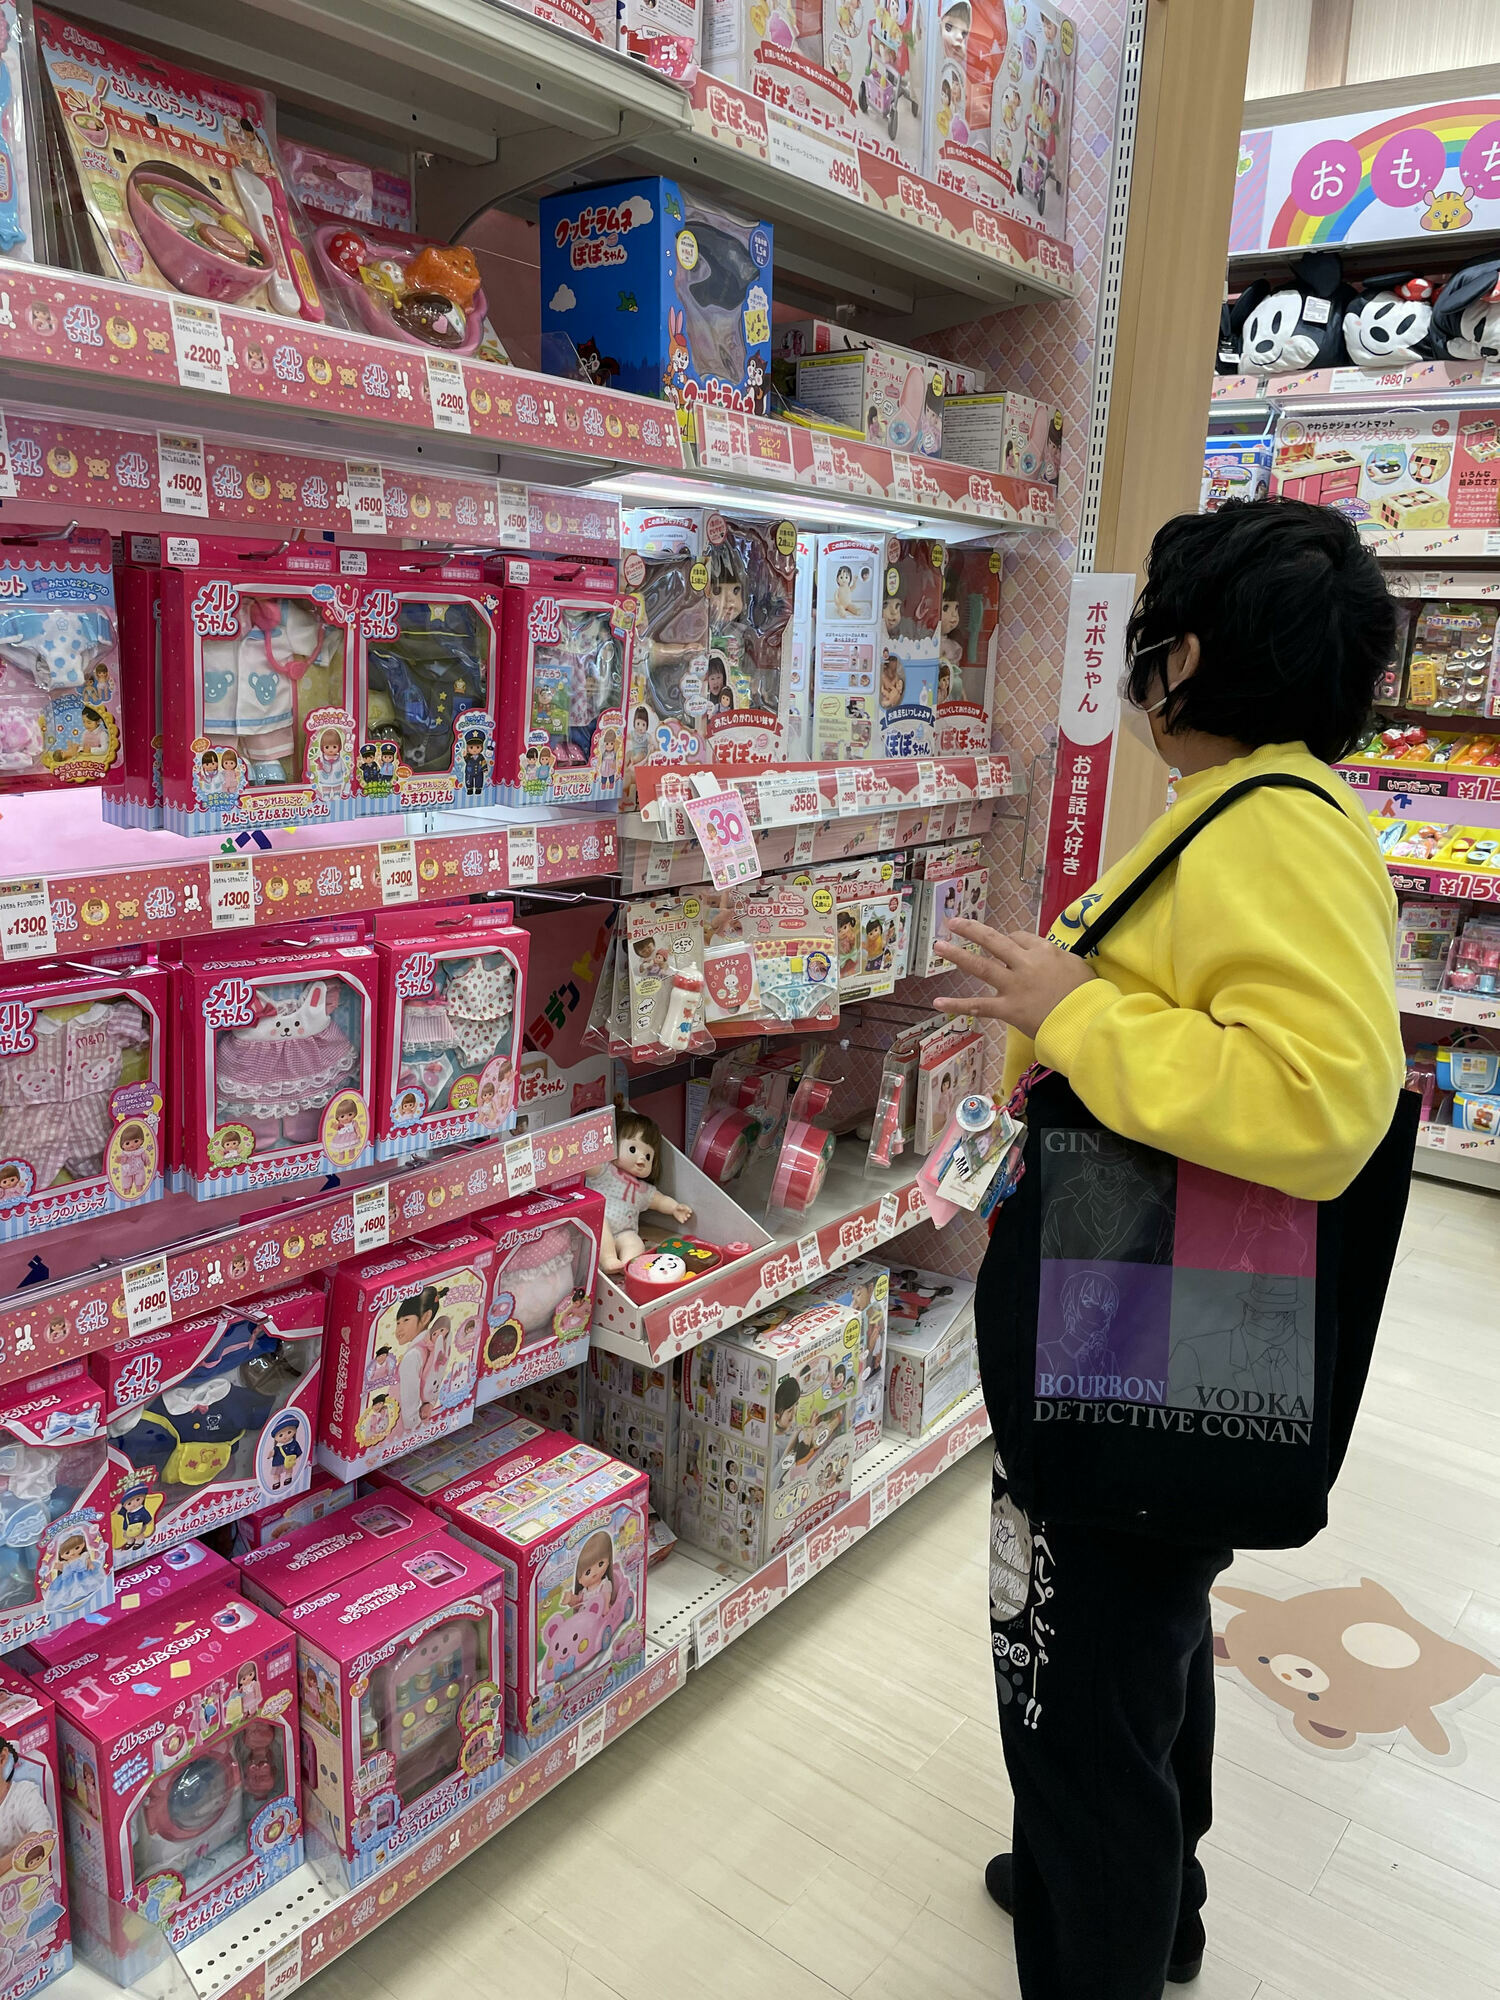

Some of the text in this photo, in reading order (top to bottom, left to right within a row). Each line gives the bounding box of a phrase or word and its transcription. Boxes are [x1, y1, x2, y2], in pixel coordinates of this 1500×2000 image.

[110, 74, 217, 131] おしょくじラーメン
[708, 88, 767, 142] ぽぽちゃん
[900, 179, 942, 223] ぽぽちゃん
[555, 207, 634, 248] クッピーラムネ
[570, 241, 627, 269] ぽぽちゃん
[66, 305, 98, 327] メル
[66, 325, 104, 347] ちゃん
[184, 344, 221, 365] ¥2200
[274, 346, 303, 367] メル
[275, 362, 305, 382] ちゃん
[364, 363, 390, 383] メル
[1376, 374, 1402, 387] ¥1980
[364, 379, 391, 398] ちゃん
[436, 393, 464, 410] ¥2200
[517, 396, 537, 412] メル
[518, 409, 540, 425] ちゃん
[584, 408, 603, 425] メル
[1307, 419, 1396, 431] やわらかジョイントマット
[585, 421, 605, 437] ちゃん
[1305, 428, 1420, 443] MYダイニングキッチン
[10, 439, 42, 461] メル
[758, 435, 781, 449] ラッピング
[11, 457, 43, 477] ちゃん
[117, 453, 148, 473] メル
[118, 469, 150, 489] ちゃん
[167, 473, 203, 492] ¥1500
[212, 465, 242, 485] メル
[1458, 478, 1498, 487] 組み立て方
[1460, 470, 1491, 479] いろんな
[215, 480, 243, 500] ちゃん
[303, 476, 327, 494] メル
[305, 491, 329, 508] ちゃん
[354, 496, 383, 512] ¥1500
[385, 487, 407, 504] メル
[456, 497, 477, 514] メル
[386, 501, 408, 519] ちゃん
[457, 511, 478, 526] ちゃん
[504, 513, 527, 529] ¥1500
[47, 588, 89, 600] おむつセット
[194, 583, 238, 613] メル
[363, 592, 396, 617] メル
[529, 597, 559, 624] メル
[195, 611, 238, 635] ちゃん
[363, 616, 399, 638] ちゃん
[529, 622, 559, 643] ちゃん
[1077, 600, 1110, 715] ポポちゃん
[713, 713, 770, 729] あたしのかわいい妹
[657, 727, 697, 754] マシュマロ
[885, 729, 931, 757] ぽぽちゃん
[940, 726, 989, 751] ぽぽちゃん
[553, 784, 591, 798] ほいくしさん
[1387, 779, 1441, 795] いつだって
[251, 794, 304, 809] あこがれおしごと
[400, 790, 454, 806] おまわりさん
[790, 793, 818, 812] ¥3580
[221, 803, 330, 825] かんごしさん&おいしゃさん
[1062, 753, 1093, 877] お世話大好き
[462, 849, 483, 866] メル
[512, 854, 534, 868] ¥1400
[318, 867, 342, 885] メル
[386, 870, 413, 886] ¥1300
[463, 862, 483, 877] ちゃん
[147, 886, 175, 906] メル
[218, 890, 250, 907] ¥1300
[319, 881, 343, 897] ちゃん
[147, 902, 177, 920] ちゃん
[748, 904, 805, 916] おむつ替えごっこ
[7, 915, 48, 936] ¥1300
[398, 954, 434, 979] メル
[207, 980, 251, 1009] メル
[398, 977, 434, 997] ちゃん
[205, 1006, 253, 1028] ちゃん
[518, 1068, 567, 1103] ぽちゃん
[428, 1126, 469, 1142] したぎセット
[1044, 1131, 1100, 1154] GIN
[248, 1160, 318, 1186] うさちゃんワンピ
[511, 1162, 532, 1180] ¥2000
[404, 1190, 424, 1206] メル
[28, 1197, 108, 1228] チェックのパジャマ
[404, 1204, 425, 1219] ちゃん
[333, 1214, 354, 1234] メル
[360, 1214, 386, 1234] ¥1600
[255, 1240, 279, 1259] メル
[495, 1226, 543, 1254] メルちゃん
[256, 1255, 281, 1271] ちゃん
[173, 1269, 198, 1290] メル
[133, 1290, 167, 1314] ¥1800
[174, 1286, 200, 1302] ちゃん
[368, 1282, 424, 1312] メルちゃん
[78, 1300, 108, 1322] メル
[672, 1302, 724, 1336] ぽぽちゃん
[78, 1315, 110, 1333] ちゃん
[122, 1353, 161, 1383] メル
[117, 1381, 157, 1403] ちゃん
[1038, 1373, 1167, 1404] BOURBON
[1195, 1385, 1311, 1420] VODKA
[1033, 1399, 1314, 1447] DETECTIVE CONAN
[381, 1422, 448, 1460] おんぶだっこひも
[148, 1489, 261, 1548] メルちゃんのようちえんふく
[527, 1539, 565, 1567] メルちゃん
[808, 1525, 849, 1564] ぽぽちゃん
[722, 1590, 770, 1630] ぽぽちゃん
[108, 1626, 212, 1687] おせんたくセット
[349, 1643, 397, 1678] メルちゃん
[43, 1651, 99, 1684] メルちゃん
[563, 1681, 614, 1721] くまさんカー
[110, 1720, 166, 1762] メルちゃん
[388, 1785, 471, 1850] じどうはんばいき
[171, 1869, 268, 1942] おせんたくセット
[269, 1961, 299, 1992] ¥3500
